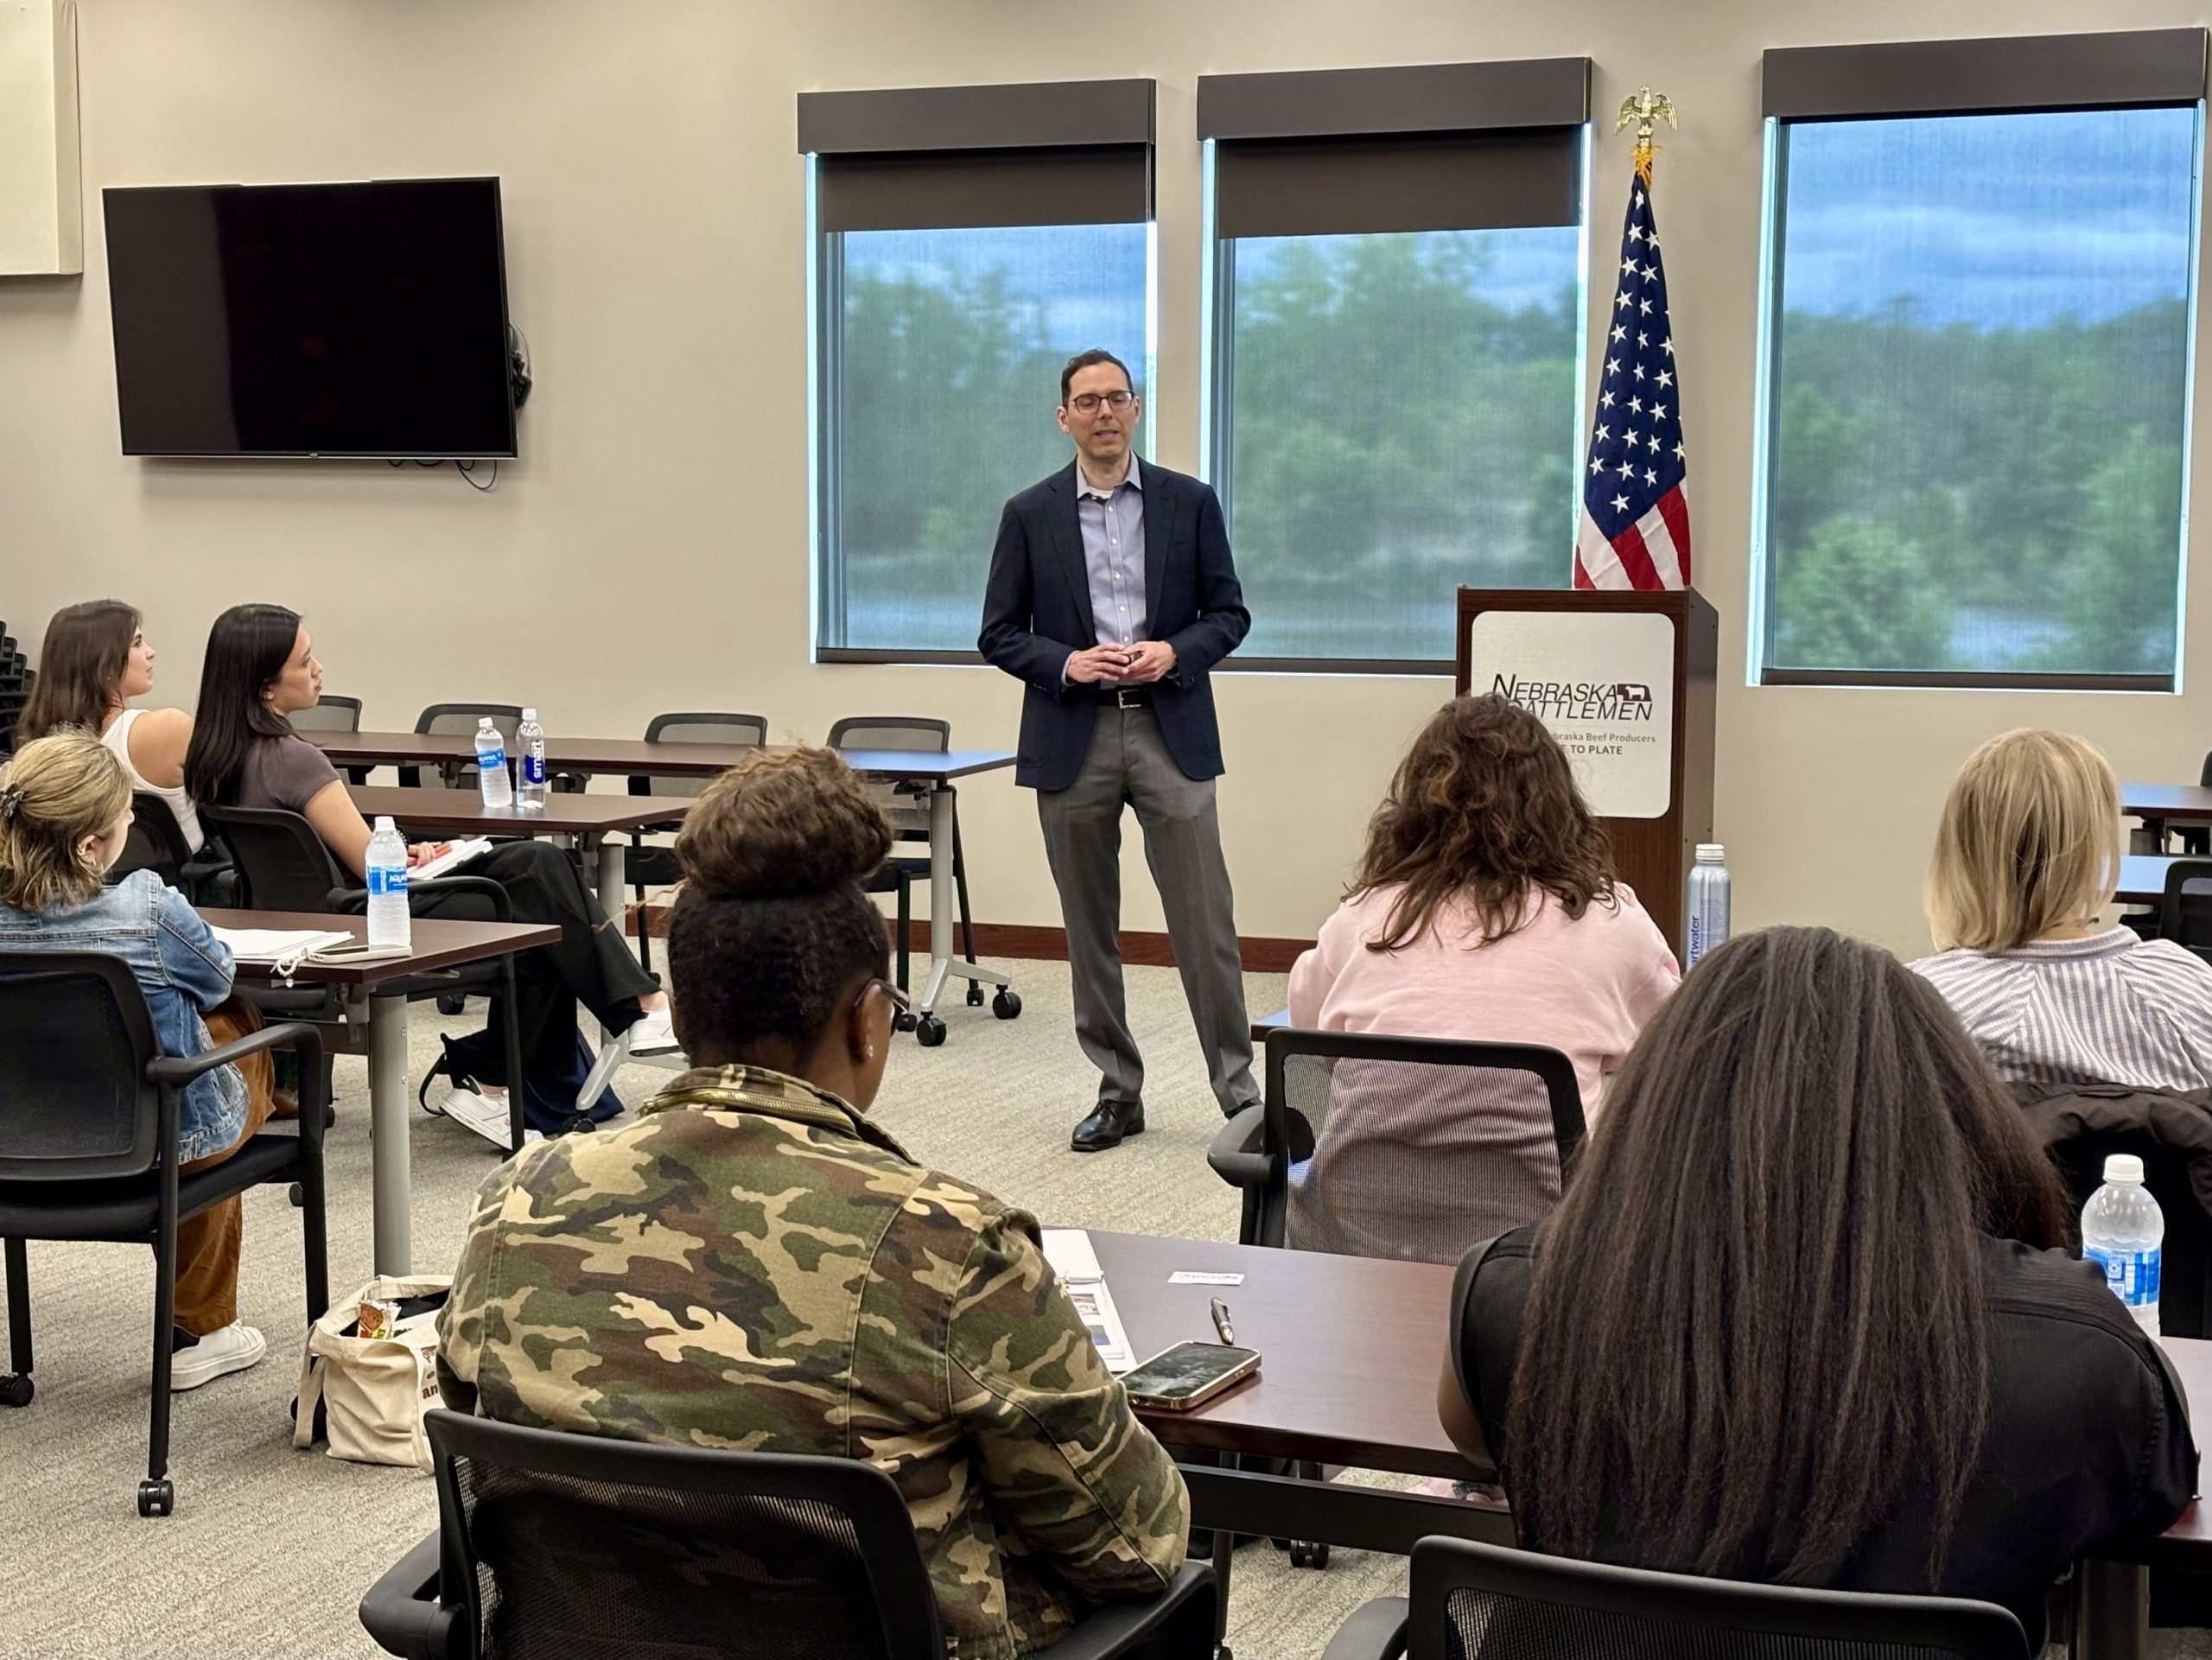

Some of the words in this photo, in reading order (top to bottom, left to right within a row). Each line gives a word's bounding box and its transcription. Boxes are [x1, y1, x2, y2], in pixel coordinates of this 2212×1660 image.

[1493, 673, 1618, 702] NEBRASKA
[1554, 732, 1583, 741] braska
[1586, 732, 1607, 741] Beef
[1609, 733, 1656, 743] Producers
[1570, 744, 1586, 754] TO
[1588, 745, 1623, 755] PLATE
[531, 740, 543, 779] smart
[1690, 915, 1700, 965] artwater
